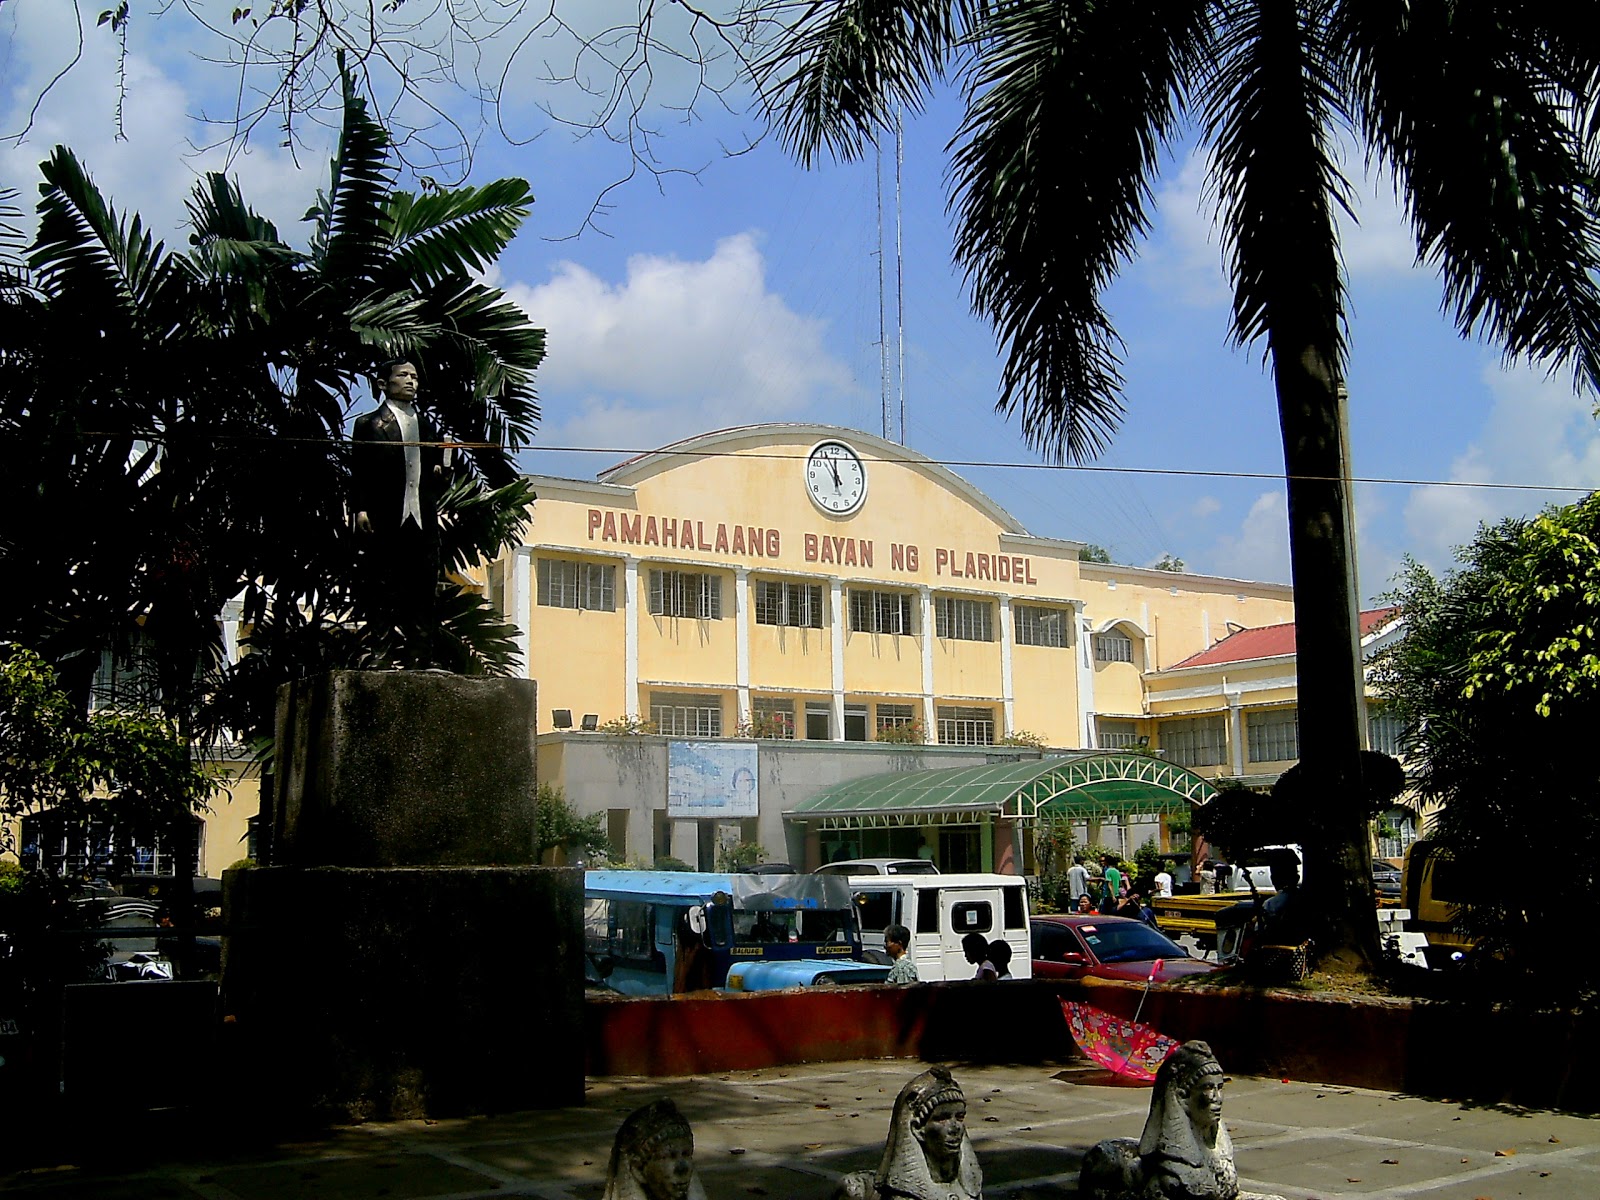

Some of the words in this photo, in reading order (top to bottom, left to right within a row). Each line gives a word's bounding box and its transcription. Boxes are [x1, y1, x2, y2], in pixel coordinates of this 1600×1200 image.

[830, 447, 840, 455] 12
[851, 463, 857, 471] 2
[810, 471, 816, 479] 9
[855, 477, 861, 485] 3
[822, 496, 827, 504] 7
[833, 501, 839, 509] 6
[588, 509, 780, 558] PAMAHALAANG
[804, 533, 873, 568] BAYAN
[891, 543, 919, 572] NG
[936, 548, 1038, 585] PLARIDEL
